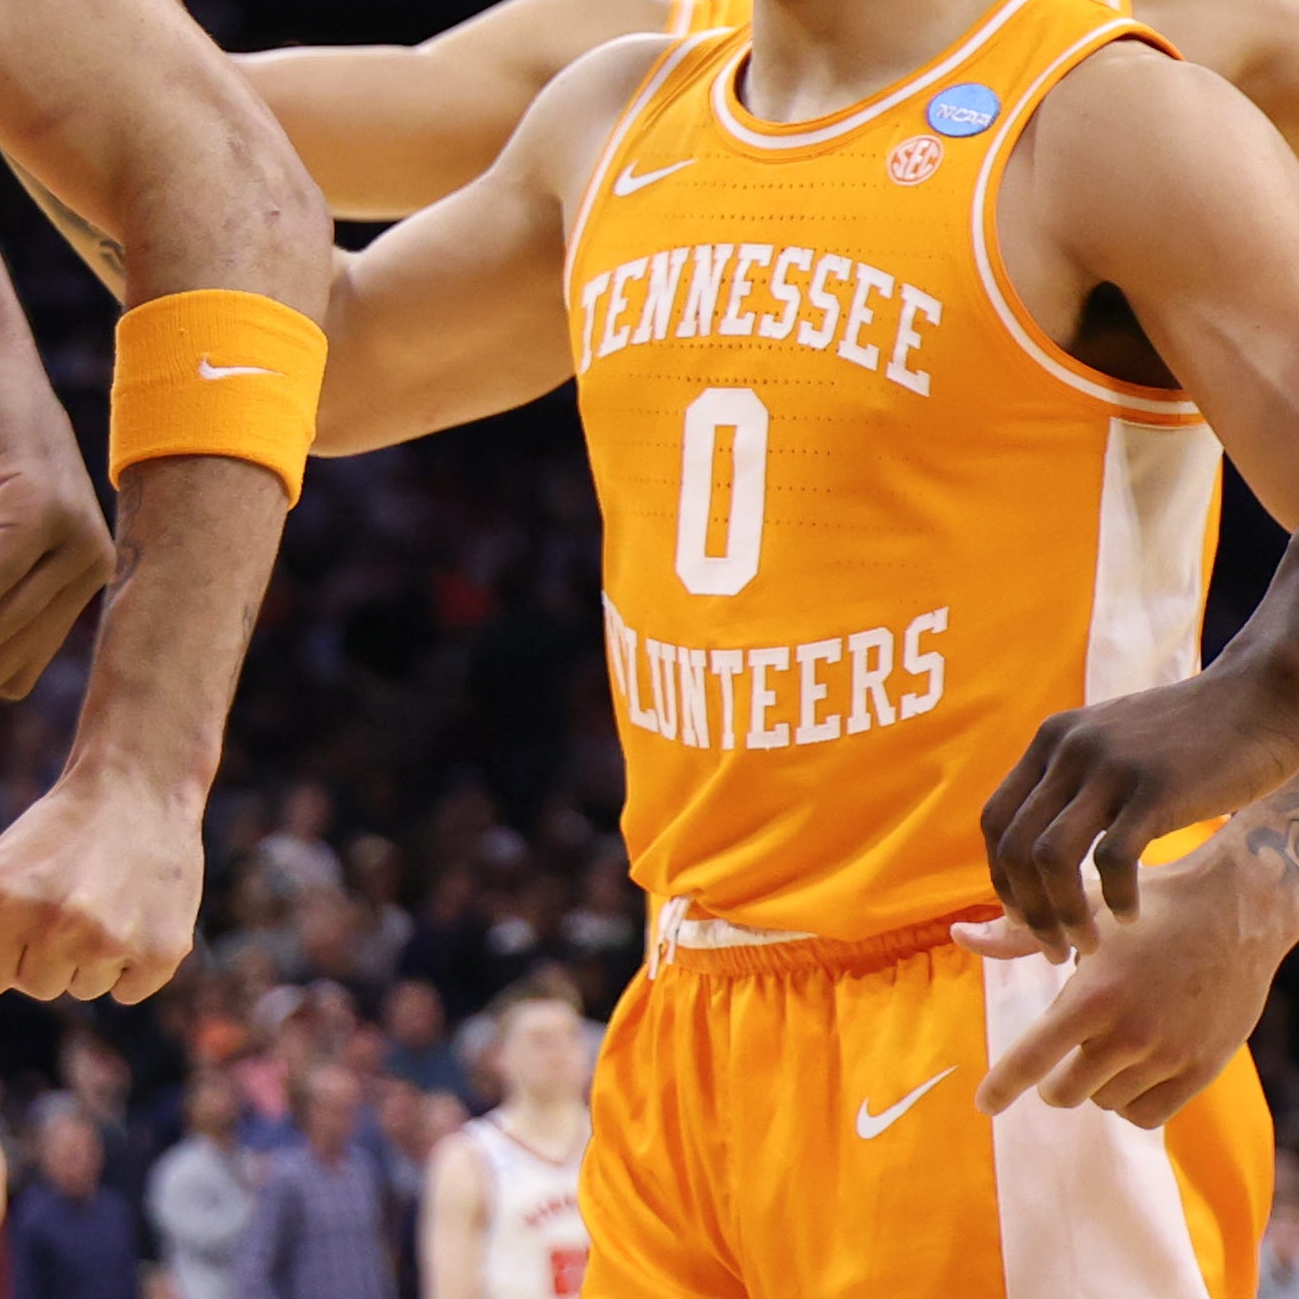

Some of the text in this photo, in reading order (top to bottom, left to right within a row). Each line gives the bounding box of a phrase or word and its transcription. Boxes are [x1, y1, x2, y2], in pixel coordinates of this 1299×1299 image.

[890, 139, 942, 181] SEC
[936, 103, 995, 130] NCAA
[579, 243, 943, 397] TENNESSEE
[674, 387, 770, 596] 0
